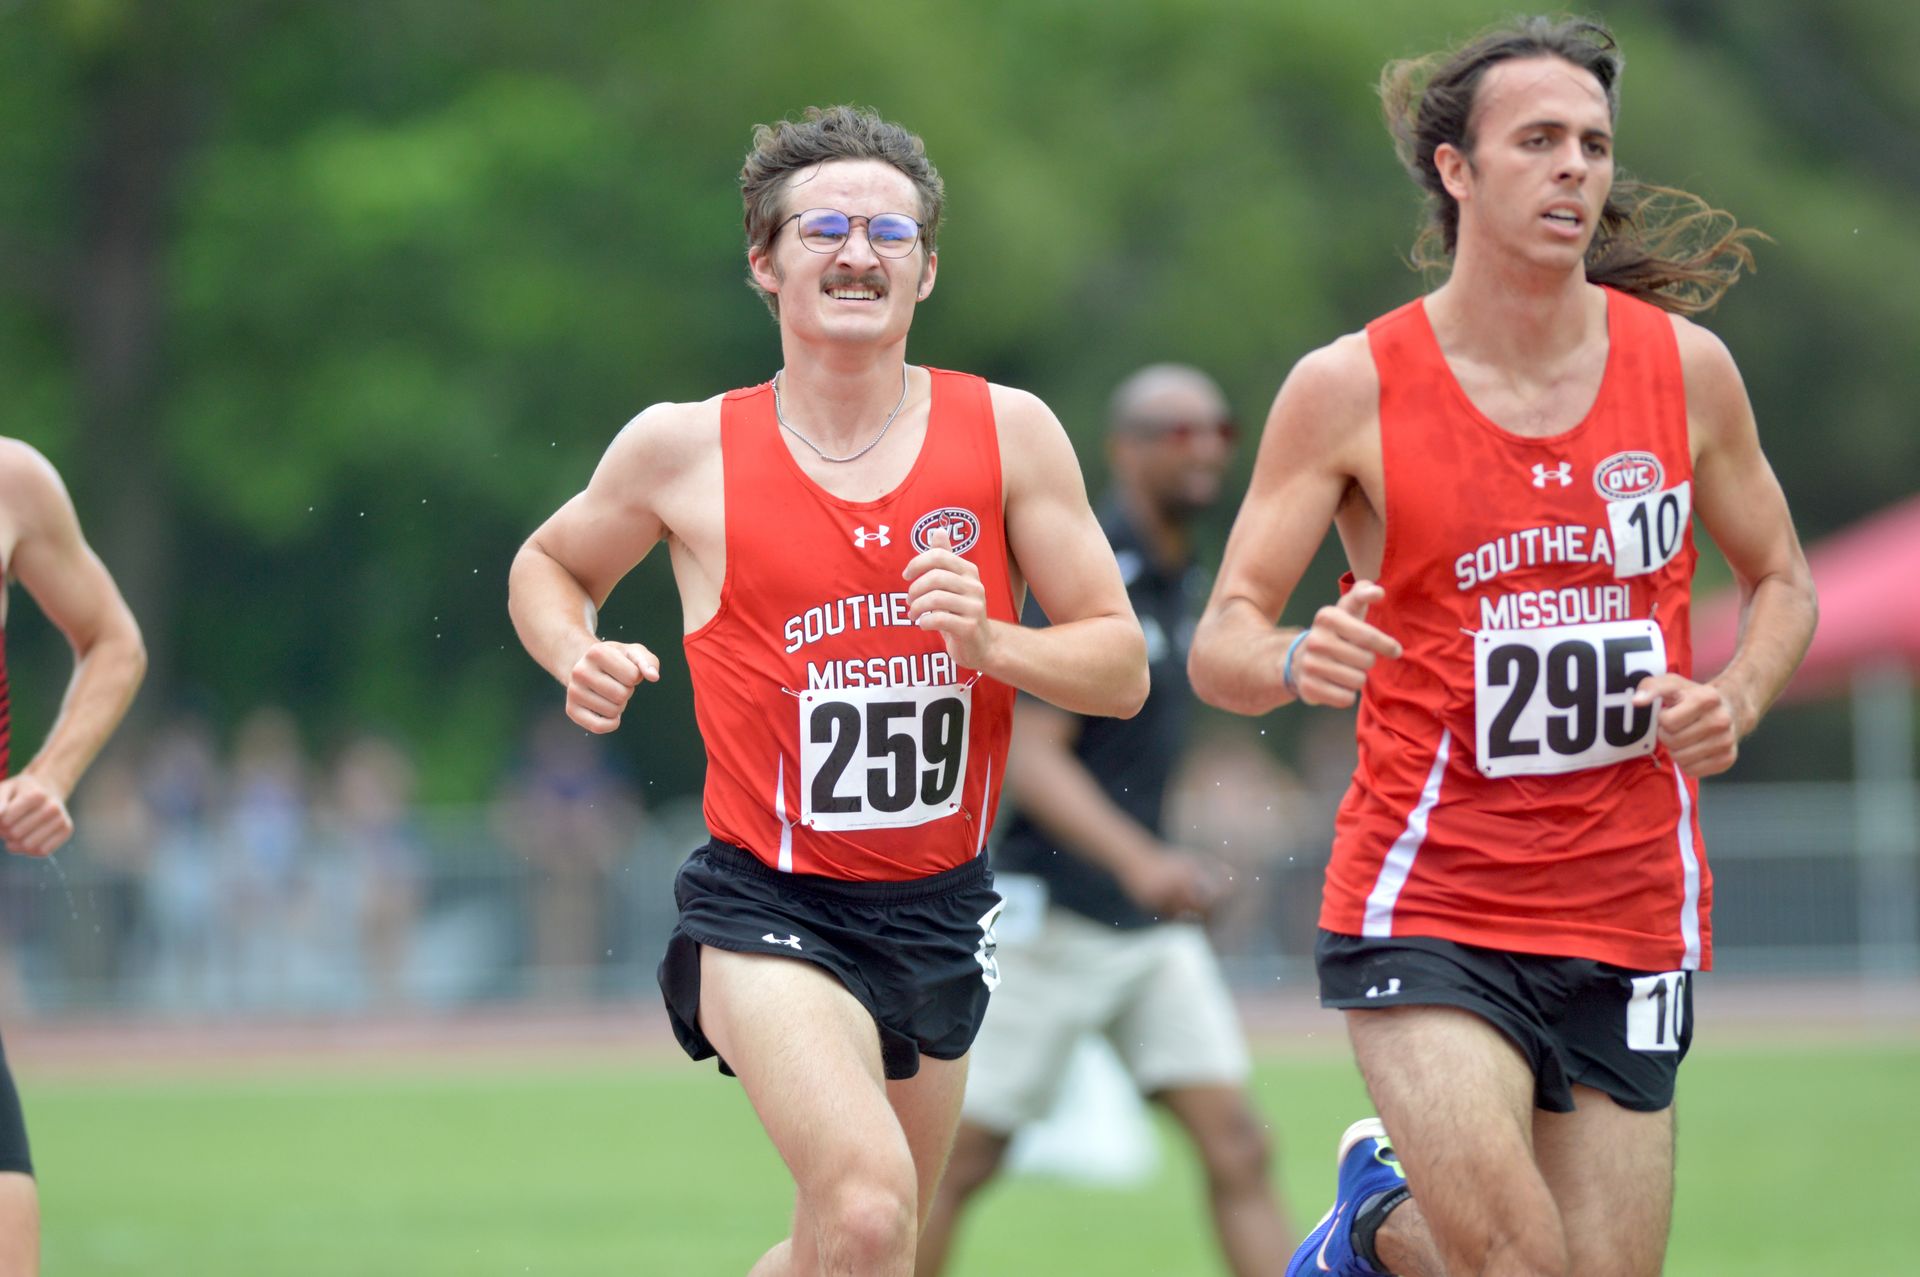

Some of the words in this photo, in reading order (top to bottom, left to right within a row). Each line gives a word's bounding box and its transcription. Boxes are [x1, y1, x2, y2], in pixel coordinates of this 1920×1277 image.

[1609, 465, 1650, 490] OVC
[1455, 525, 1613, 591] SOUTHEA
[1628, 493, 1679, 568] 10
[784, 592, 932, 654] SOUTHE
[1480, 584, 1630, 631] MISSOURI
[807, 651, 957, 691] MISSOURI
[1487, 635, 1655, 759] 295
[810, 697, 965, 814] 259
[1647, 975, 1685, 1045] 10
